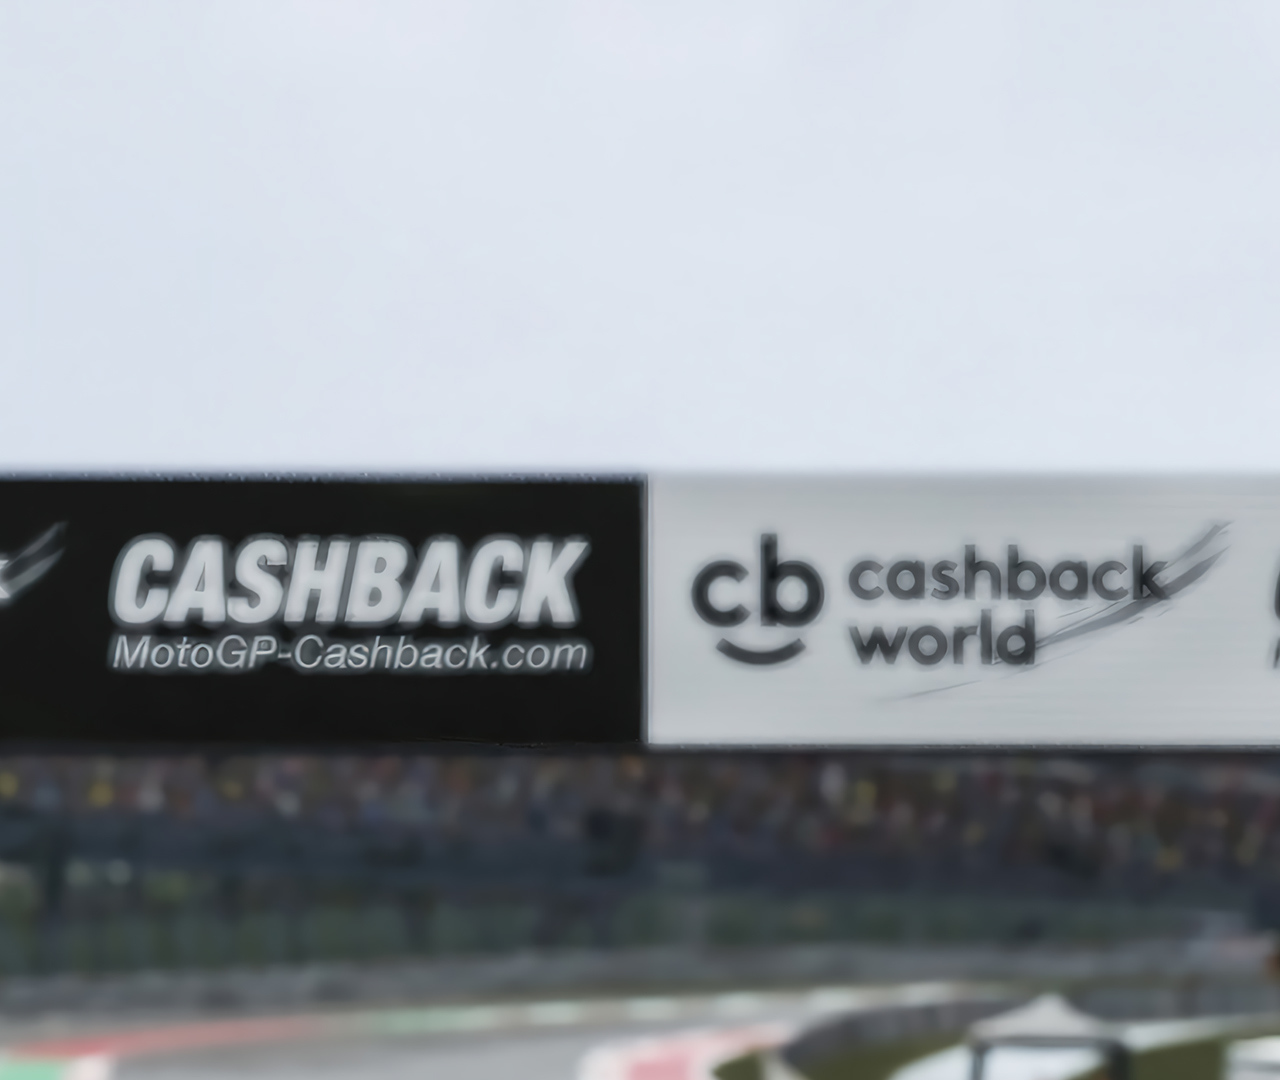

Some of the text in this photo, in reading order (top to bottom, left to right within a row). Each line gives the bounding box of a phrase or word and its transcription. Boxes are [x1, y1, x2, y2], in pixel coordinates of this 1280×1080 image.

[113, 537, 589, 625] CASHBACK
[690, 533, 825, 627] cb
[847, 544, 1170, 601] cashback
[113, 634, 588, 669] MotoGP-Cashback.com
[847, 608, 1037, 666] world
